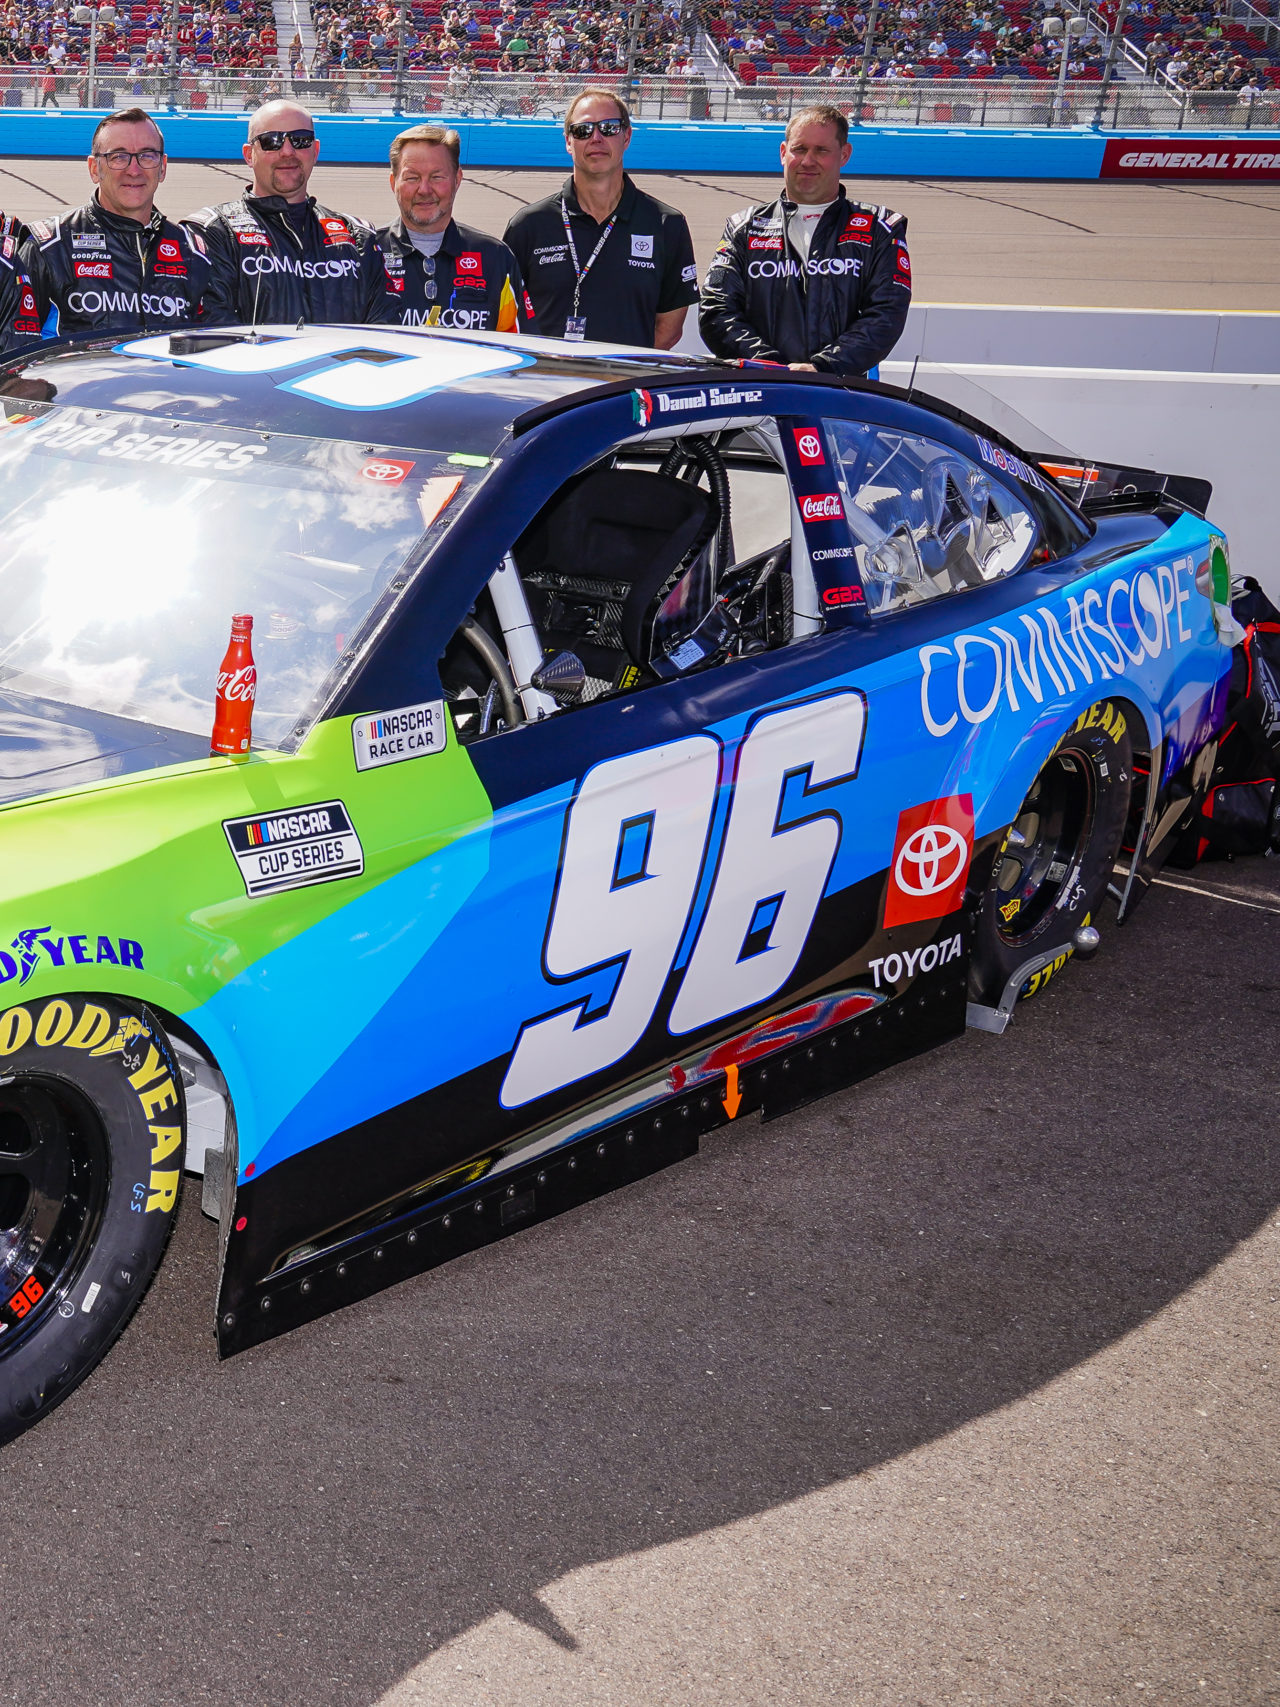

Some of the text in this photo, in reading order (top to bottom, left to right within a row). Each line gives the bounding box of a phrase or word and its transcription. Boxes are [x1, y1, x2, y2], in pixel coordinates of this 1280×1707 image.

[1119, 152, 1230, 169] GENERAL
[71, 252, 112, 261] GOODYEAR
[627, 259, 656, 270] TOYOTA
[77, 263, 111, 277] Coca-Cola
[453, 276, 487, 289] GBR
[659, 391, 707, 412] Daniel
[24, 422, 269, 471] CUP SERIES
[803, 495, 841, 519] Coca-Cola
[812, 547, 854, 561] COMMSCOPE
[822, 585, 865, 605] GBR
[919, 559, 1192, 738] COMMSCOPE
[382, 708, 434, 737] NASCAR
[369, 731, 434, 759] RACE CAR
[269, 810, 333, 842] NASCAR
[258, 840, 345, 876] CUP SERIES
[500, 694, 866, 1108] 96
[868, 933, 962, 989] TOYOTA
[8, 1275, 45, 1319] 96
